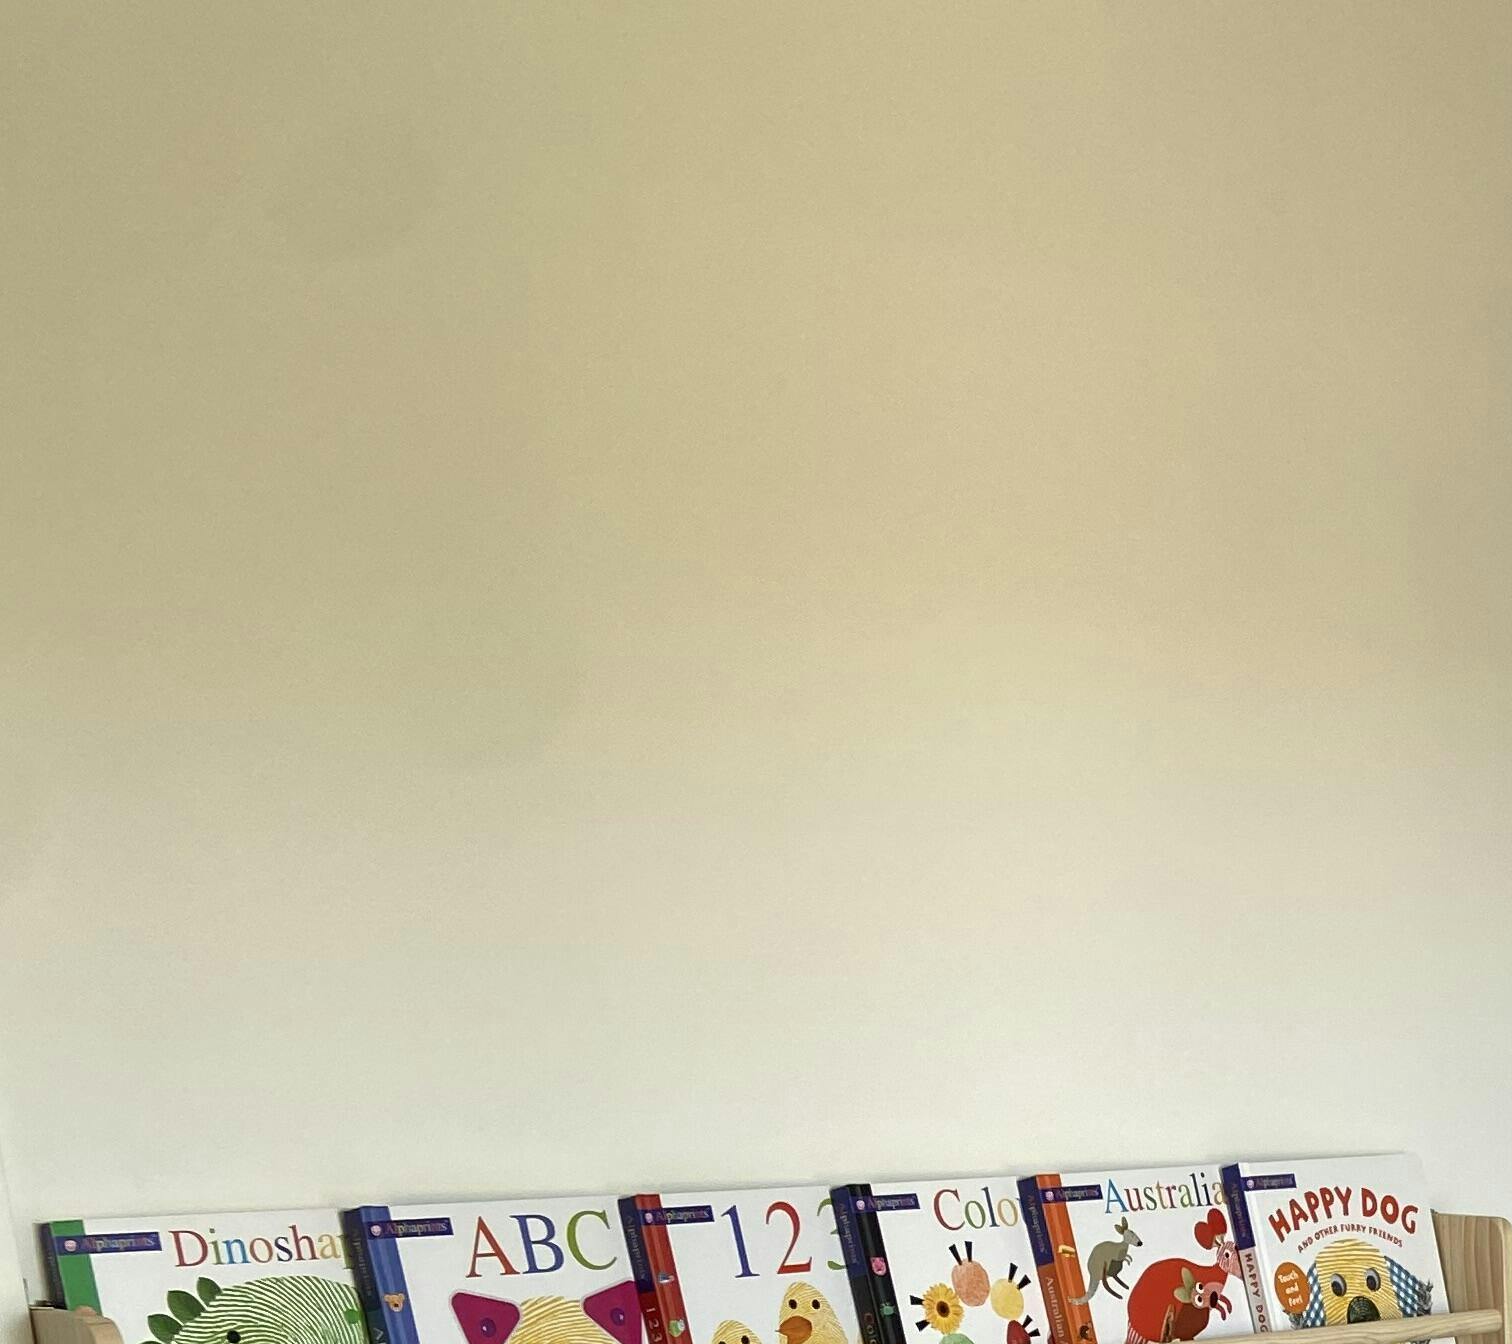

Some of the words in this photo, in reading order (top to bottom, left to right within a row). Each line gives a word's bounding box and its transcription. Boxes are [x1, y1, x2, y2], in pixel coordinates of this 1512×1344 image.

[933, 1187, 1019, 1231] Colo
[1105, 1172, 1226, 1214] Australia
[1268, 1186, 1352, 1243] HAPPY
[1361, 1187, 1418, 1234] DOG
[466, 1210, 617, 1277] ABC
[1298, 1237, 1314, 1253] AND
[1315, 1225, 1338, 1243] OTHER
[1340, 1223, 1366, 1234] FURRY
[1368, 1225, 1403, 1248] FRIENDS
[1245, 1253, 1261, 1298] HAPPY
[1278, 1271, 1299, 1284] Touch
[1285, 1285, 1299, 1294] and
